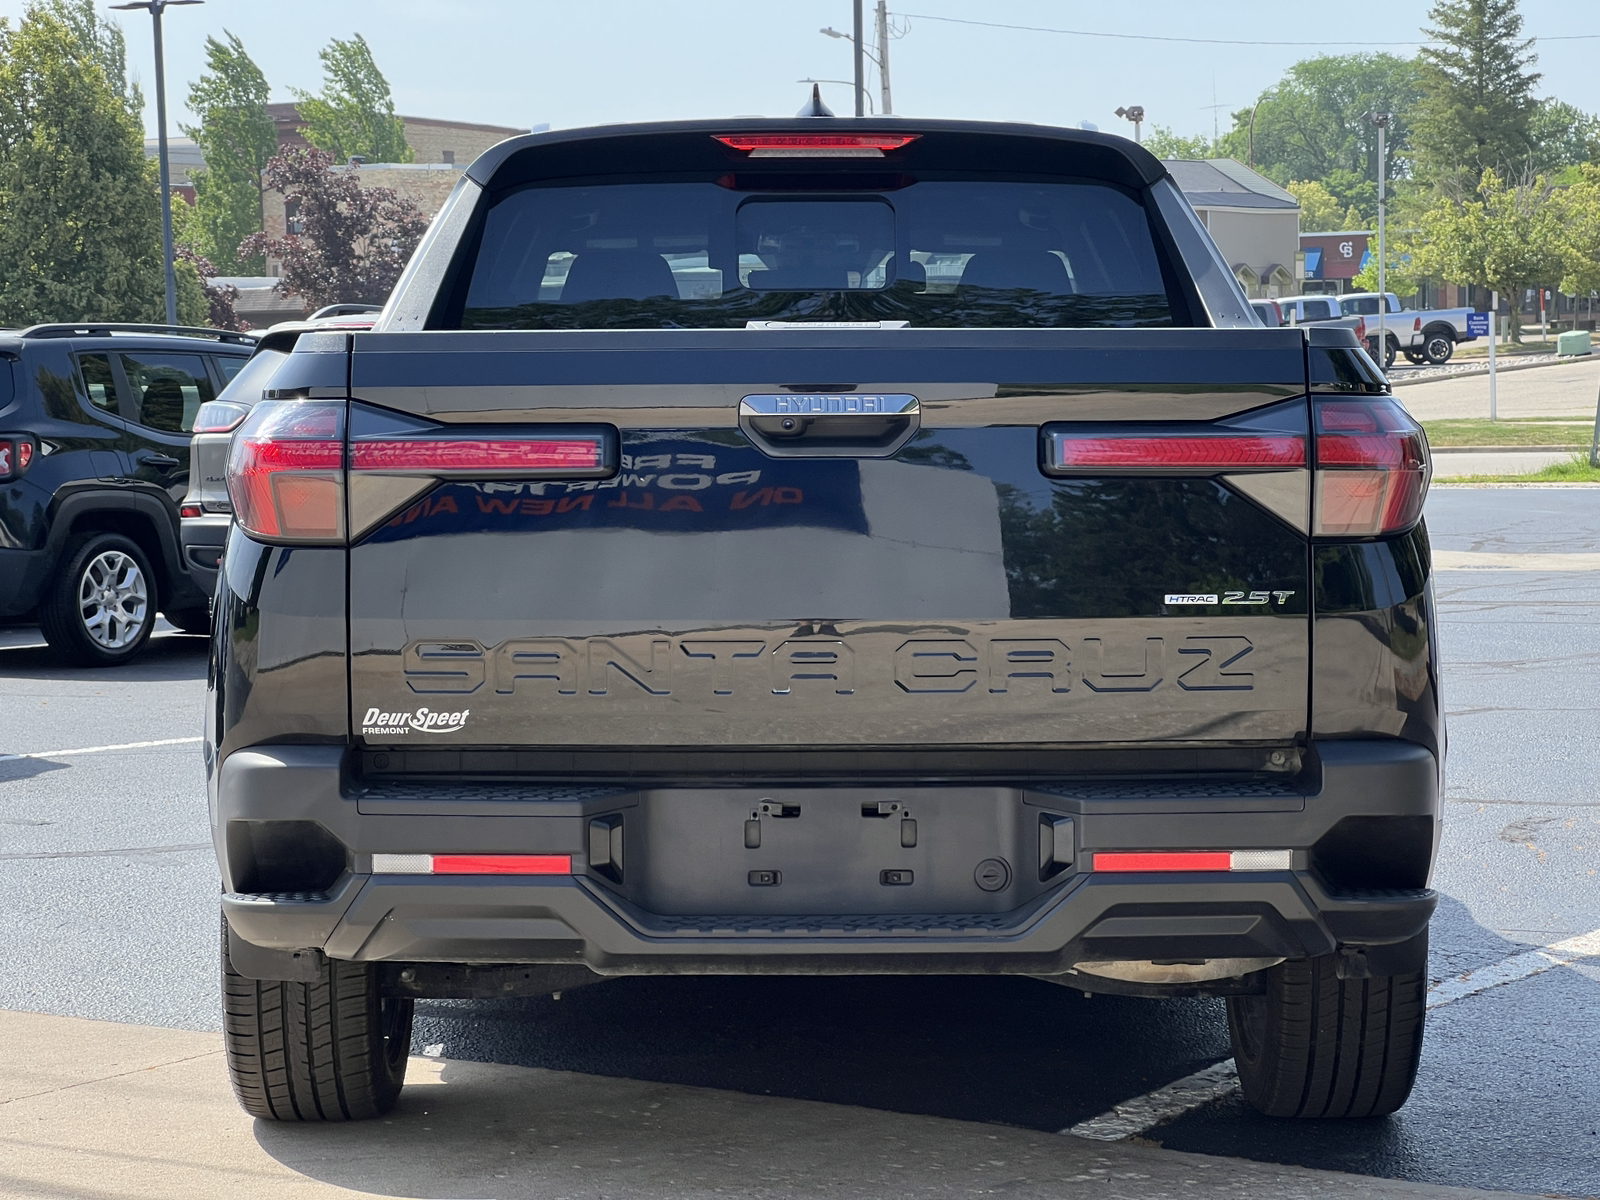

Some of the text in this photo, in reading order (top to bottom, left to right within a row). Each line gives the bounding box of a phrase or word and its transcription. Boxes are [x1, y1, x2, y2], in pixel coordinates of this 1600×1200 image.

[775, 397, 885, 413] HYUNDAI
[1169, 595, 1215, 603] HTRAC
[402, 636, 1254, 695] SANTA CRUZ
[362, 727, 410, 735] FREMONT
